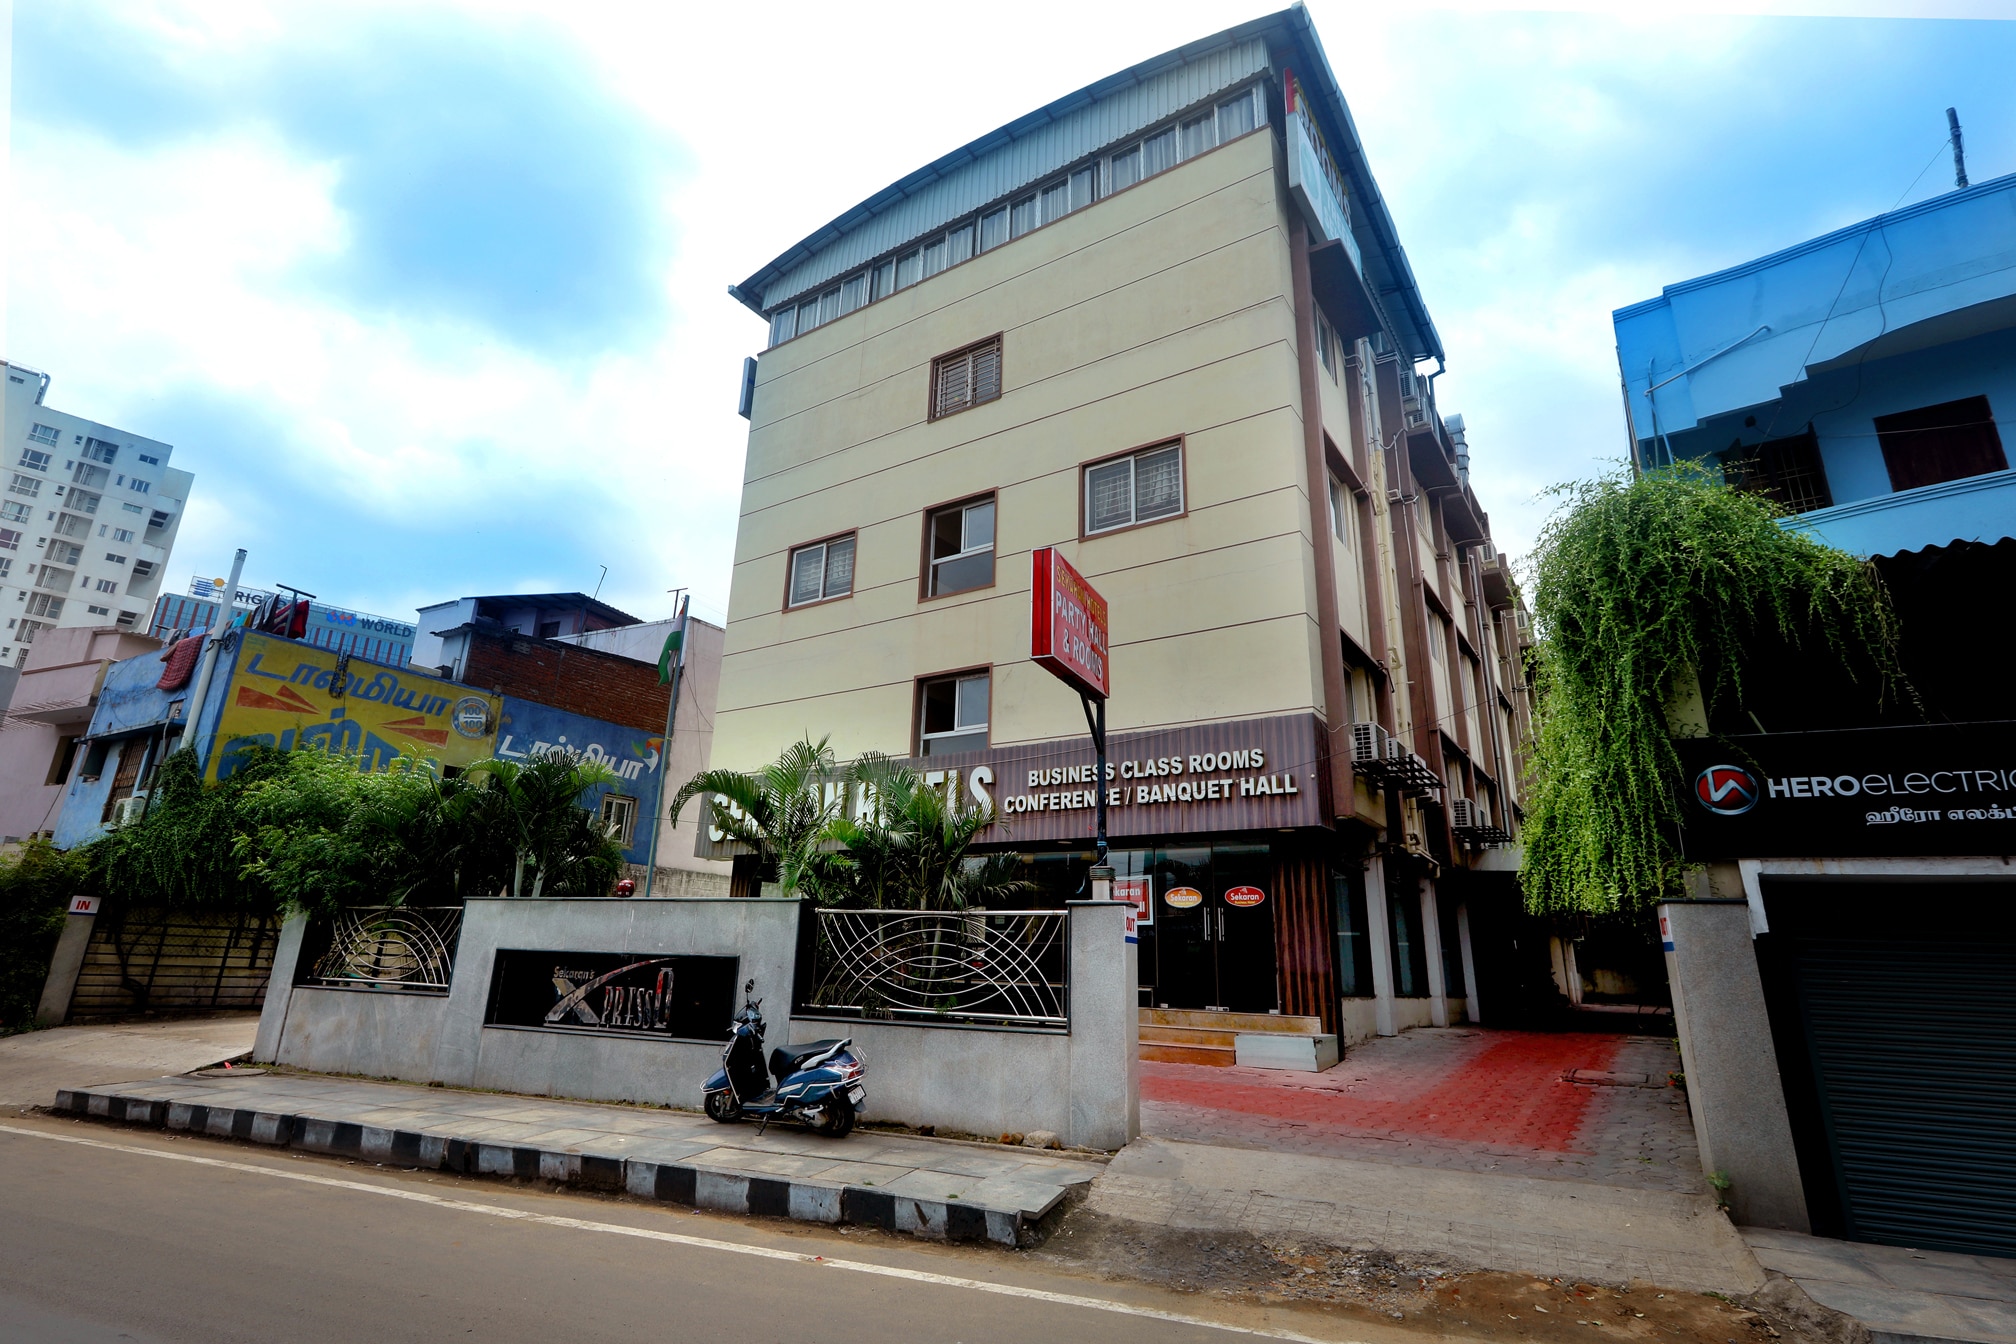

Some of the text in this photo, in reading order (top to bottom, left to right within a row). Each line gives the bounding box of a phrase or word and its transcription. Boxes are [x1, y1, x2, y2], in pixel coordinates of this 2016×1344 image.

[361, 617, 412, 638] WORLD
[1056, 590, 1107, 656] PARTY HALL
[1063, 628, 1102, 680] & ROOMS
[1121, 756, 1183, 779] CLASS
[1189, 748, 1265, 774] ROOMS
[1004, 788, 1121, 814] CONFERENE
[1137, 778, 1234, 804] BANQUET
[1240, 773, 1298, 798] HALL
[1865, 805, 1942, 826] ஹீரோ
[75, 900, 91, 911] IN
[1170, 893, 1198, 902] Sekaran
[1230, 892, 1260, 901] Sekaran
[1126, 916, 1135, 932] OUT
[553, 965, 596, 980] Sekaran's
